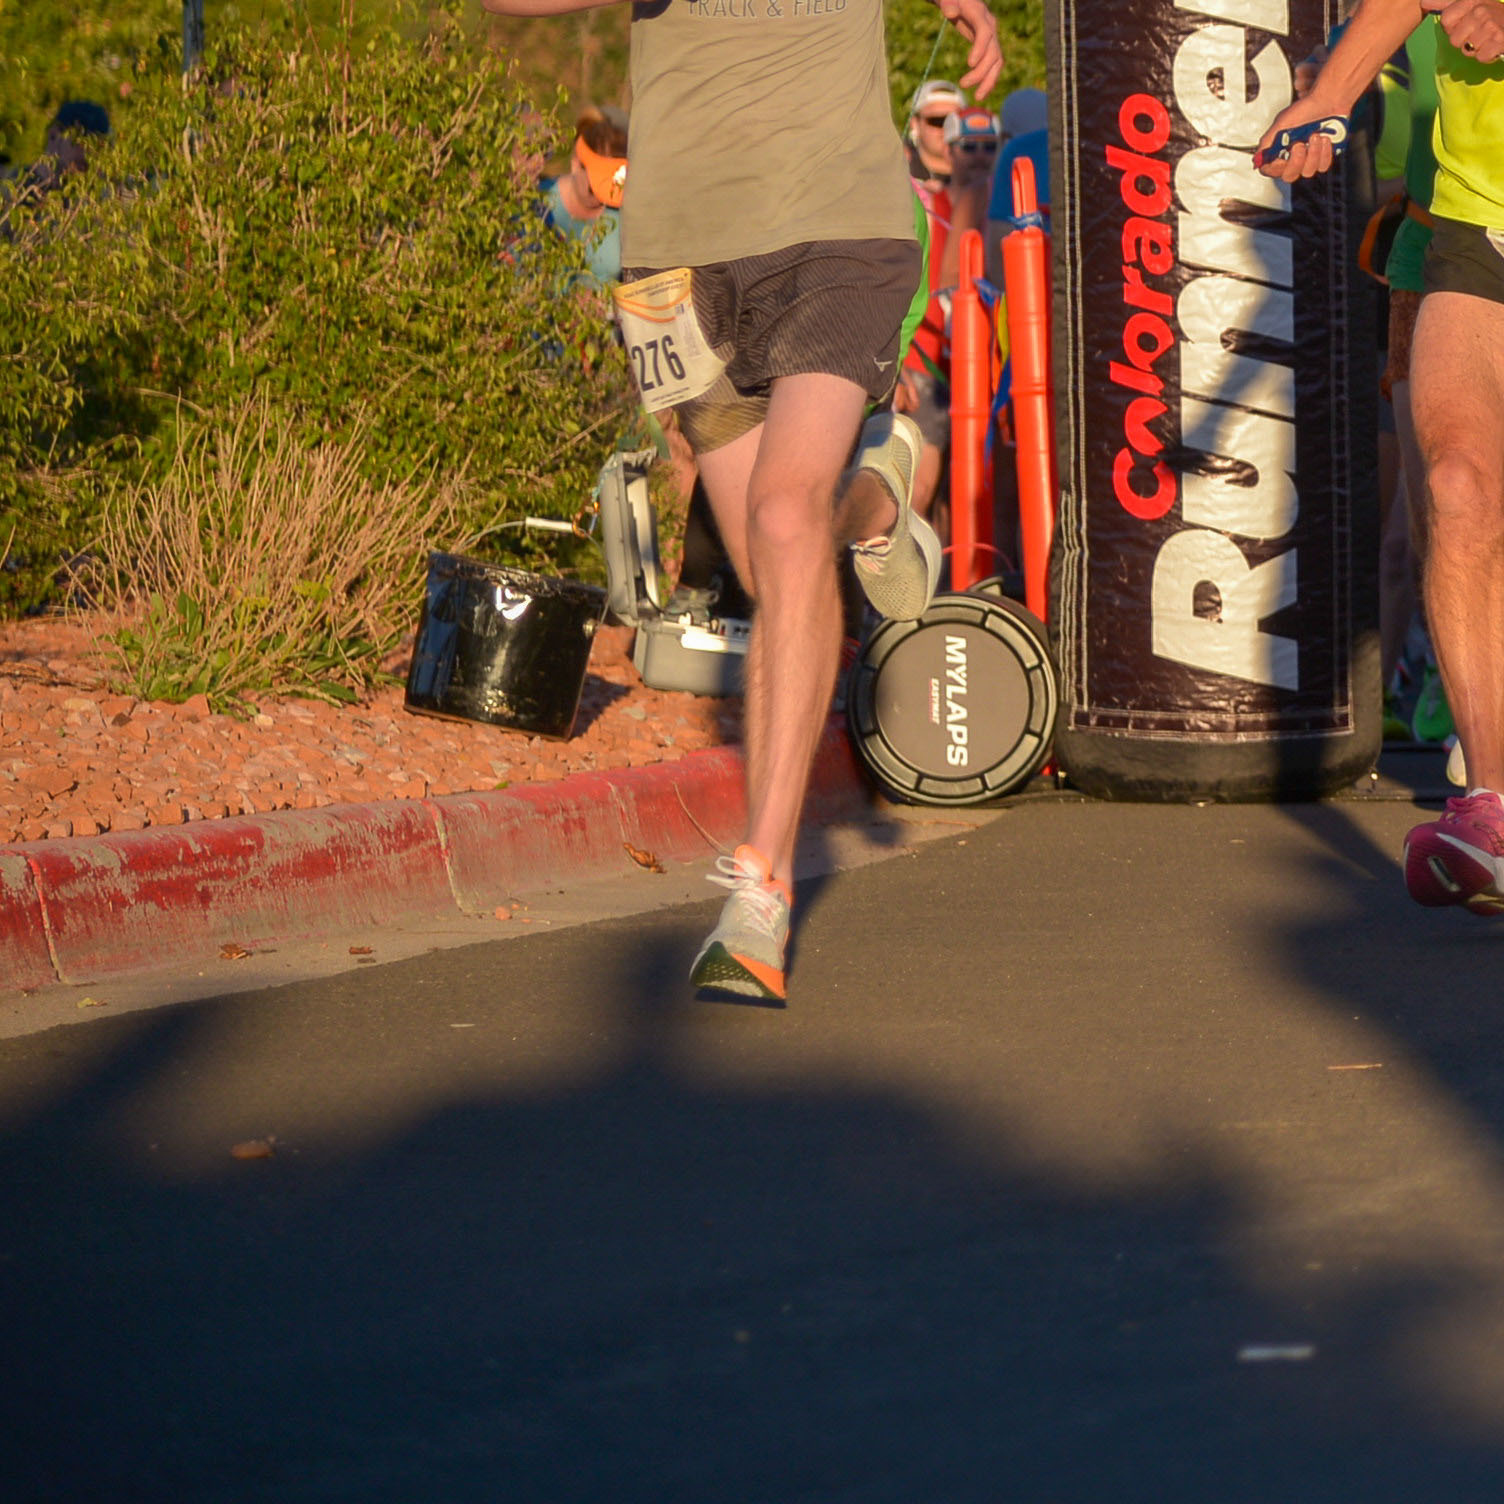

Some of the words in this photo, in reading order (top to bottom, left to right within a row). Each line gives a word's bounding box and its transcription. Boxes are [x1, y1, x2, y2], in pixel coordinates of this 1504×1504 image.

[631, 334, 686, 392] 276
[1105, 93, 1176, 520] Colorado
[945, 634, 968, 767] MYLAPS
